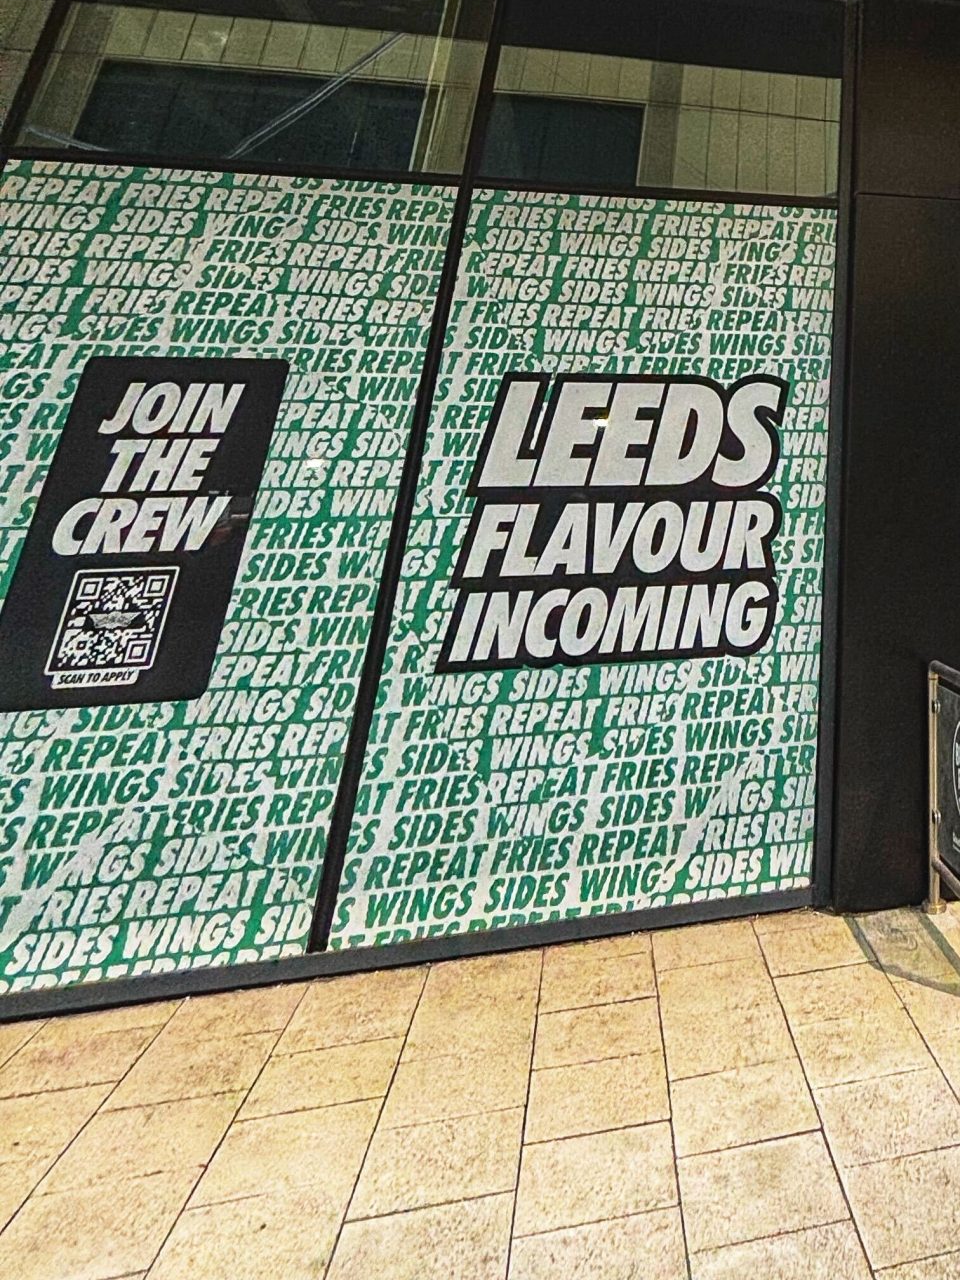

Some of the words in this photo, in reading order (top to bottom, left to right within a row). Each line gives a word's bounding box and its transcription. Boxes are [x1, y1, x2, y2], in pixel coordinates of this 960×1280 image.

[0, 176, 120, 204] REPEAT
[119, 183, 205, 209] FRIES
[204, 188, 313, 215] REPEAT
[311, 195, 384, 219] FRIES
[0, 204, 106, 231] WINGS
[110, 209, 199, 235] SIDES
[309, 219, 382, 246] SIDES
[487, 205, 558, 231] FRIES
[557, 209, 650, 235] REPEAT
[651, 214, 714, 238] FRIES
[715, 218, 798, 241] REPEAT
[0, 230, 86, 257] FRIES
[84, 234, 206, 262] REPEAT
[203, 239, 287, 266] FRIES
[290, 243, 390, 272] REPEAT
[465, 251, 561, 277] REPEAT
[562, 257, 631, 280] FRIES
[633, 259, 722, 284] REPEAT
[723, 263, 788, 286] FRIES
[482, 228, 554, 252] SIDES
[556, 231, 642, 258] WINGS
[646, 237, 712, 260] SIDES
[716, 240, 799, 265] WINGS
[83, 261, 192, 288] WINGS
[195, 265, 283, 292] SIDES
[287, 268, 384, 297] WINGS
[466, 276, 555, 301] WINGS
[557, 280, 629, 305] SIDES
[635, 282, 716, 308] WINGS
[720, 284, 786, 310] SIDES
[81, 287, 175, 313] FRIES
[171, 291, 298, 318] REPEAT
[292, 295, 370, 320] FRIES
[469, 300, 541, 326] FRIES
[541, 304, 638, 330] REPEAT
[639, 306, 706, 331] FRIES
[706, 310, 796, 332] REPEAT
[170, 318, 274, 344] WINGS
[464, 326, 538, 352] SIDES
[542, 328, 633, 355] WINGS
[636, 330, 702, 354] SIDES
[709, 333, 786, 357] WINGS
[97, 382, 245, 434] JOIN
[478, 381, 784, 488] LEEDS
[100, 439, 220, 493] THE
[51, 497, 232, 557] CREW
[250, 522, 338, 549] FRIES
[462, 499, 775, 578] FLAVOUR
[242, 553, 332, 581] SIDES
[218, 619, 301, 653] SIDES
[449, 583, 770, 662] INCOMING
[57, 673, 86, 685] SCAN
[87, 672, 101, 683] TO
[101, 670, 134, 683] APPLY
[400, 672, 503, 707] WINGS
[509, 666, 590, 702] SIDES
[599, 660, 692, 696] WINGS
[697, 656, 774, 688] SIDES
[183, 687, 300, 725] WINGS
[403, 705, 488, 742] FRIES
[488, 698, 602, 737] REPEAT
[603, 692, 681, 728] FRIES
[681, 686, 786, 721] REPEAT
[42, 731, 188, 772] REPEAT
[188, 724, 282, 760] FRIES
[396, 738, 484, 777] SIDES
[489, 731, 593, 770] WINGS
[599, 725, 677, 760] SIDES
[685, 718, 774, 752] WINGS
[39, 768, 165, 811] WINGS
[168, 761, 274, 798] SIDES
[396, 773, 482, 813] FRIES
[484, 764, 599, 804] REPEAT
[600, 758, 679, 794] FRIES
[681, 749, 783, 787] REPEAT
[25, 804, 168, 850] REPEAT
[172, 795, 265, 837] FRIES
[388, 807, 479, 850] SIDES
[487, 799, 590, 840] WINGS
[595, 790, 678, 829] SIDES
[153, 832, 258, 877] SIDES
[363, 842, 490, 890] REPEAT
[490, 834, 573, 876] FRIES
[576, 822, 687, 867] REPEAT
[693, 812, 764, 857] FRIES
[123, 869, 266, 920] REPEAT
[365, 880, 479, 929] WINGS
[483, 870, 570, 914] SIDES
[579, 858, 680, 903] WINGS
[684, 847, 763, 890] SIDES
[4, 925, 120, 976] SIDES
[123, 909, 252, 959] WINGS
